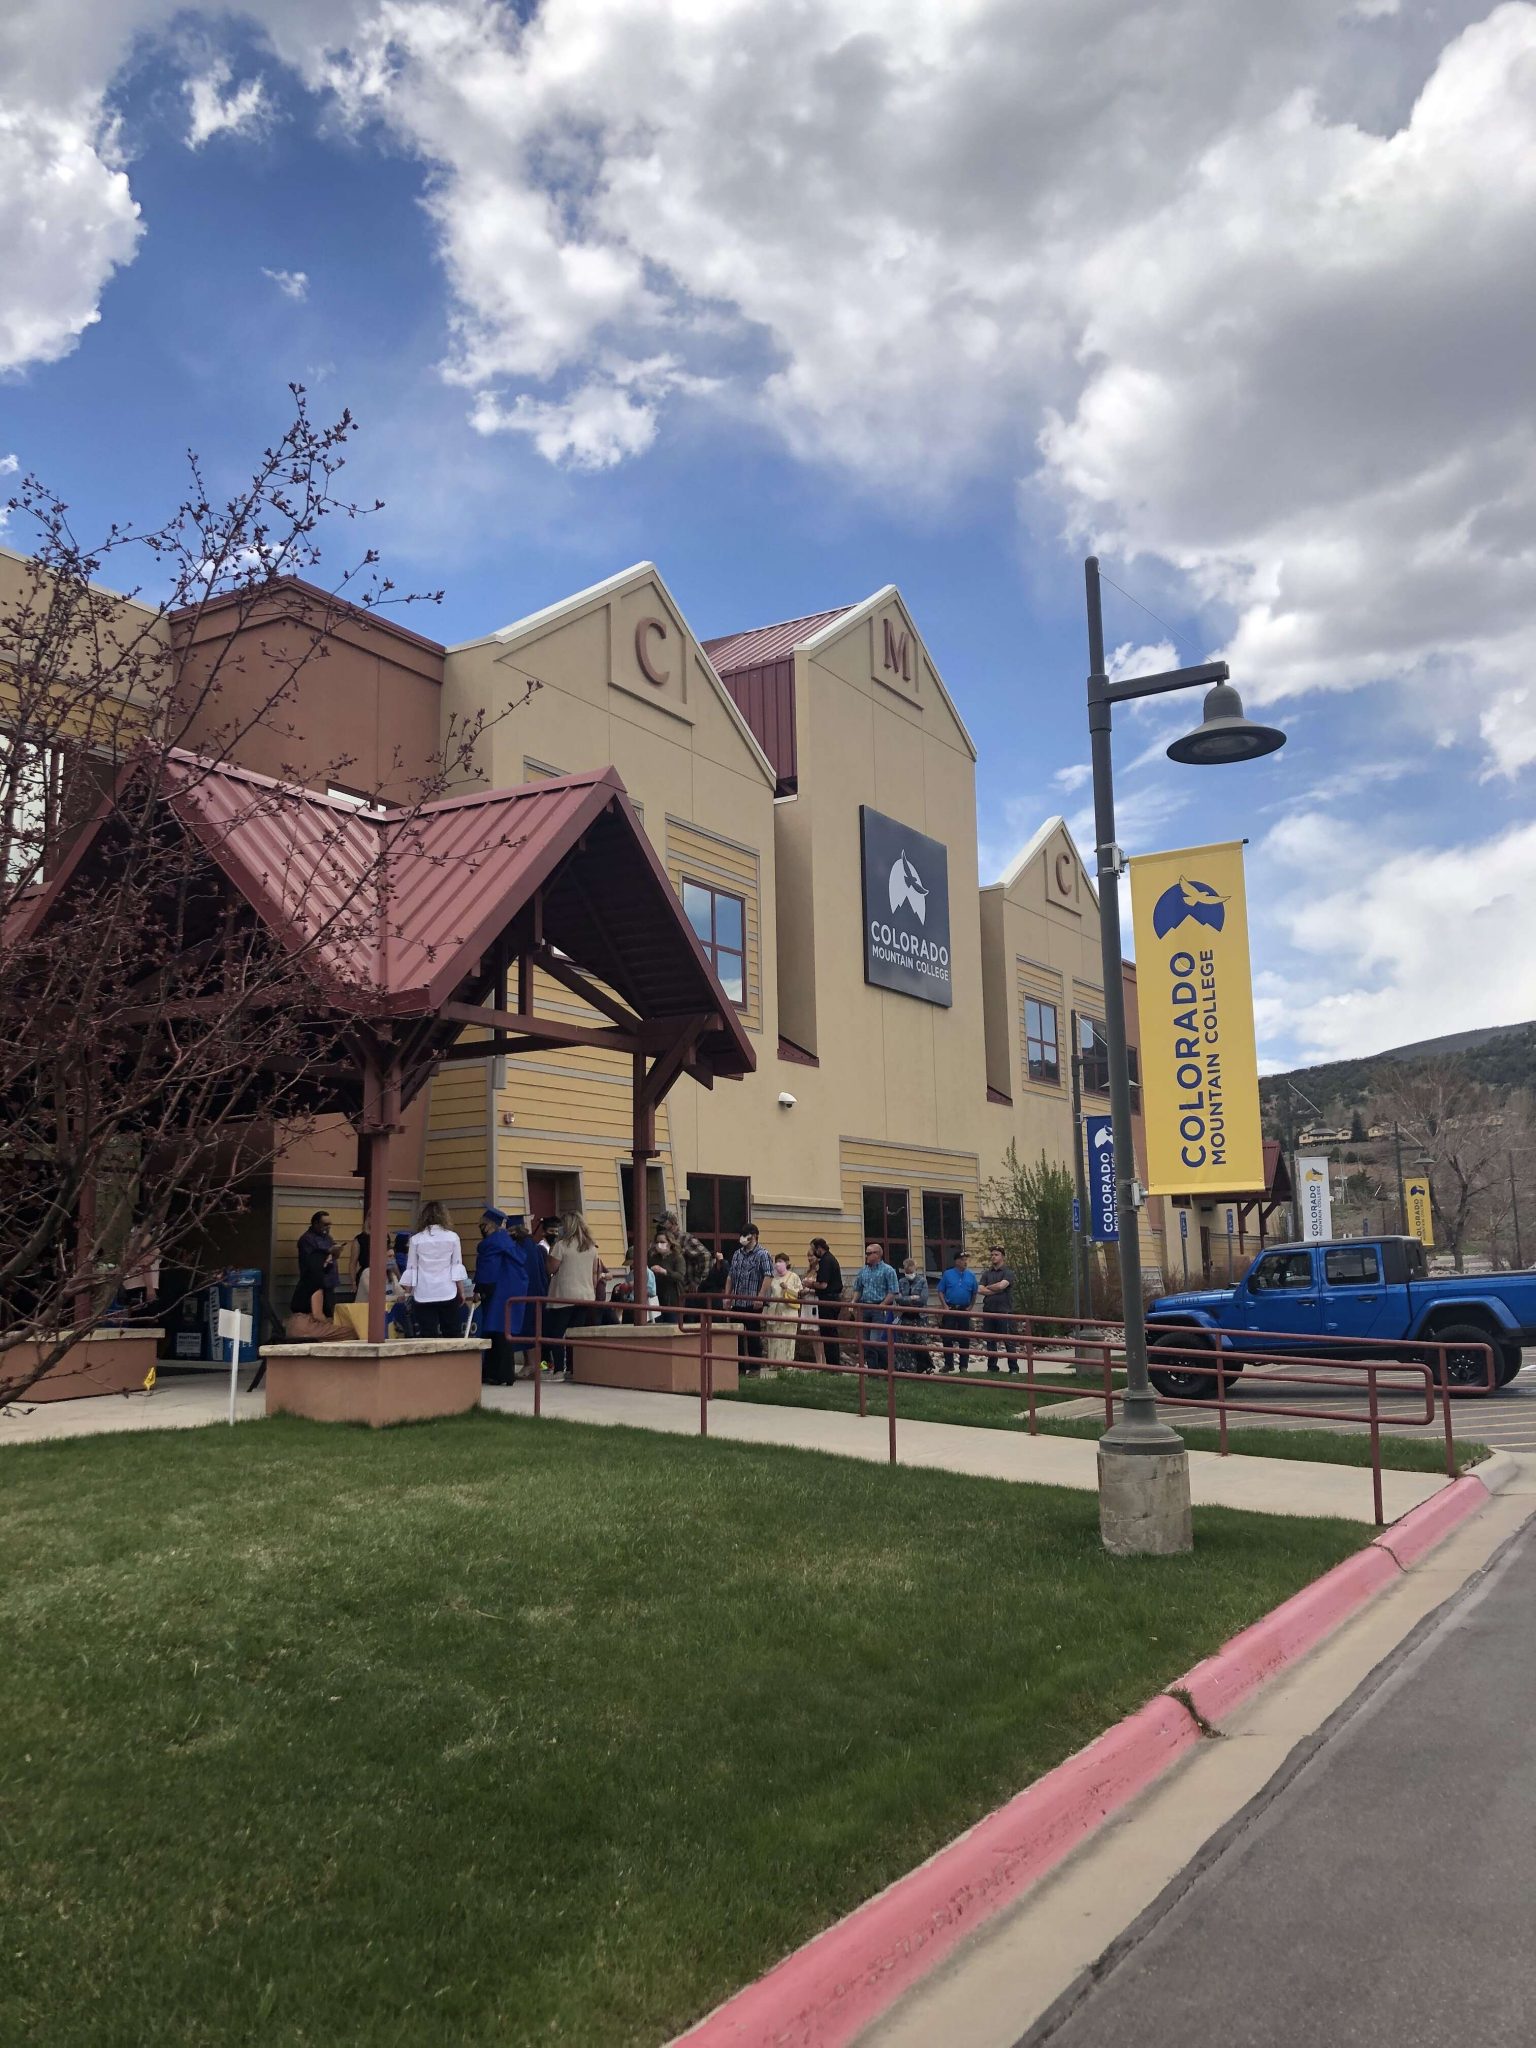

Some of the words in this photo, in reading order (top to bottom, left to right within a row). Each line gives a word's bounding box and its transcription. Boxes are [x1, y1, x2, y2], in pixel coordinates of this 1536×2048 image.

[635, 617, 670, 686] C
[883, 618, 911, 681] M
[1056, 852, 1073, 896] C
[871, 920, 949, 966] COLORADO
[872, 944, 914, 970] MOUNTAIN
[916, 960, 949, 982] COLLEGE
[1200, 949, 1219, 1044] COLLEGE
[1169, 951, 1207, 1168] COLORADO
[1206, 1053, 1226, 1166] MOUNTAIN
[1100, 1152, 1113, 1233] COLORADO
[1309, 1185, 1319, 1237] COLORADO
[1413, 1198, 1422, 1238] OLORADO
